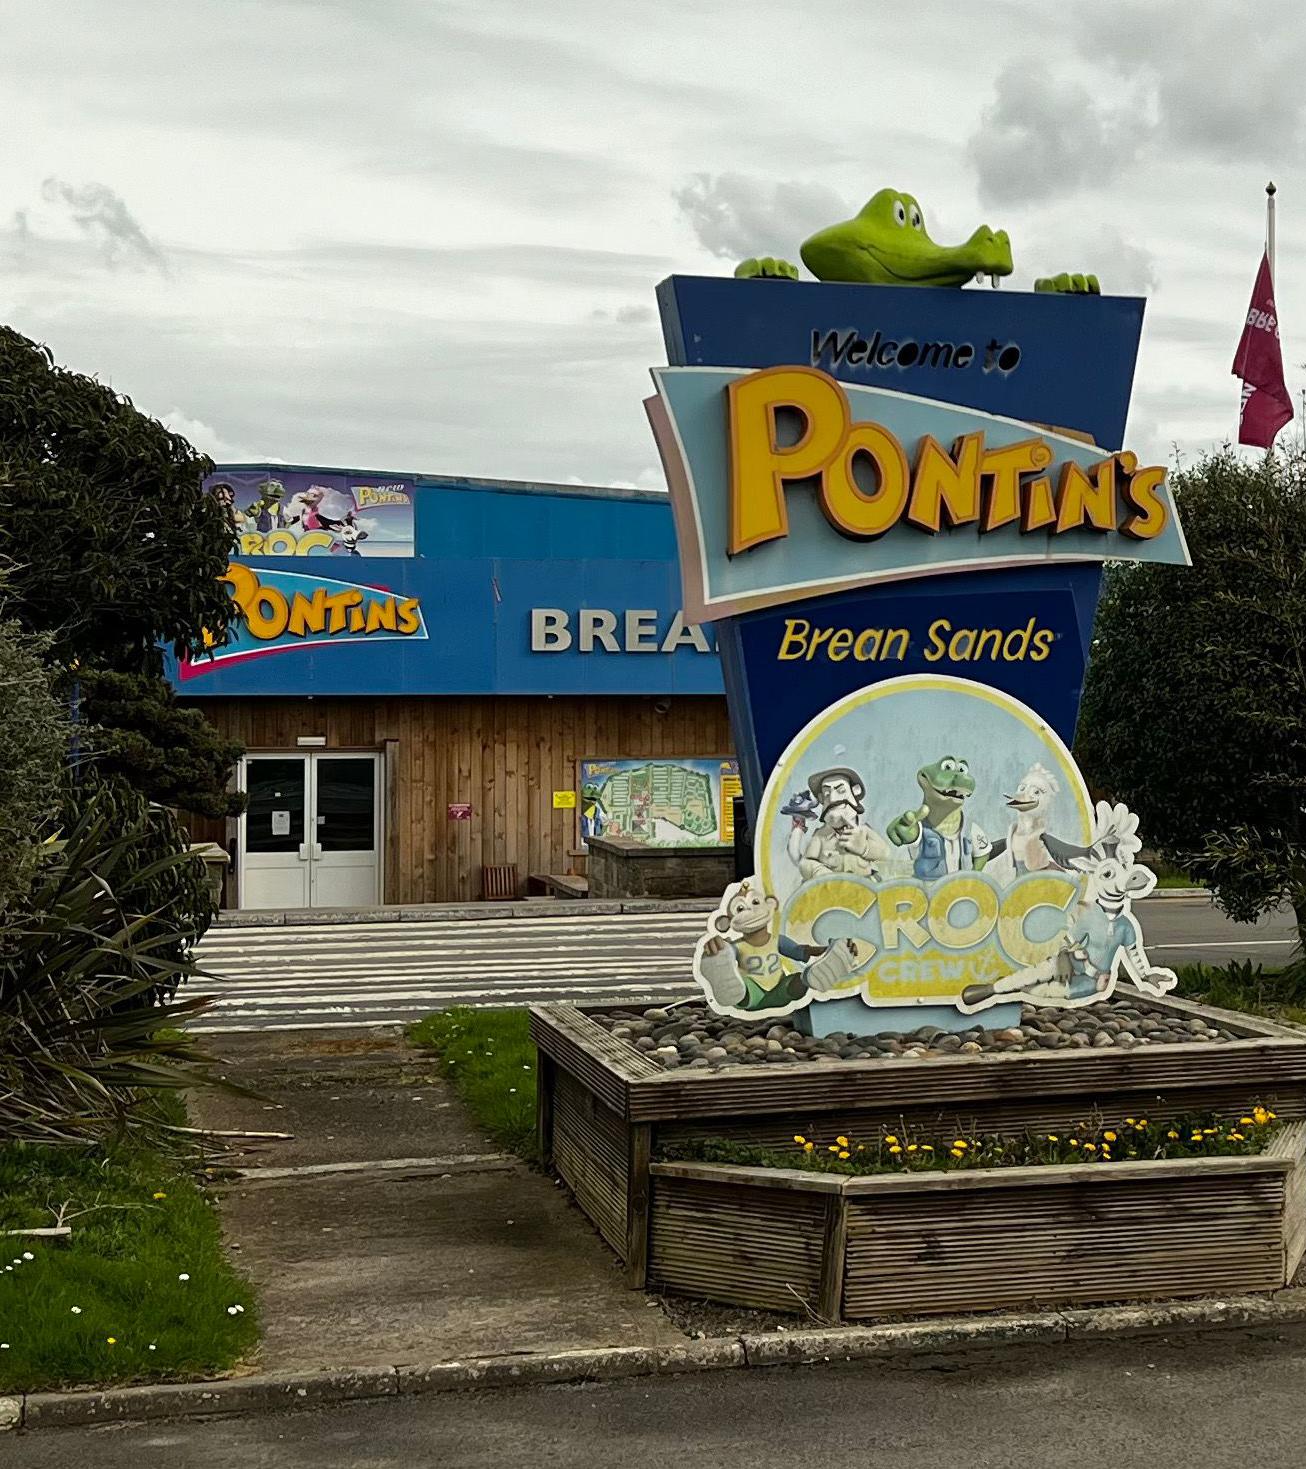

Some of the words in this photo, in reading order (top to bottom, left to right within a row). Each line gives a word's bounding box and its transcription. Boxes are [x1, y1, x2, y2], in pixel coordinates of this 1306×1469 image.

[811, 328, 974, 369] Welcome
[983, 338, 1021, 373] to
[239, 530, 334, 556] ROC
[532, 608, 719, 652] BREA
[777, 619, 911, 661] Brean
[924, 617, 1055, 661] Sands
[785, 877, 1077, 970] CROC
[747, 953, 779, 975] 22
[878, 958, 965, 984] CREW
